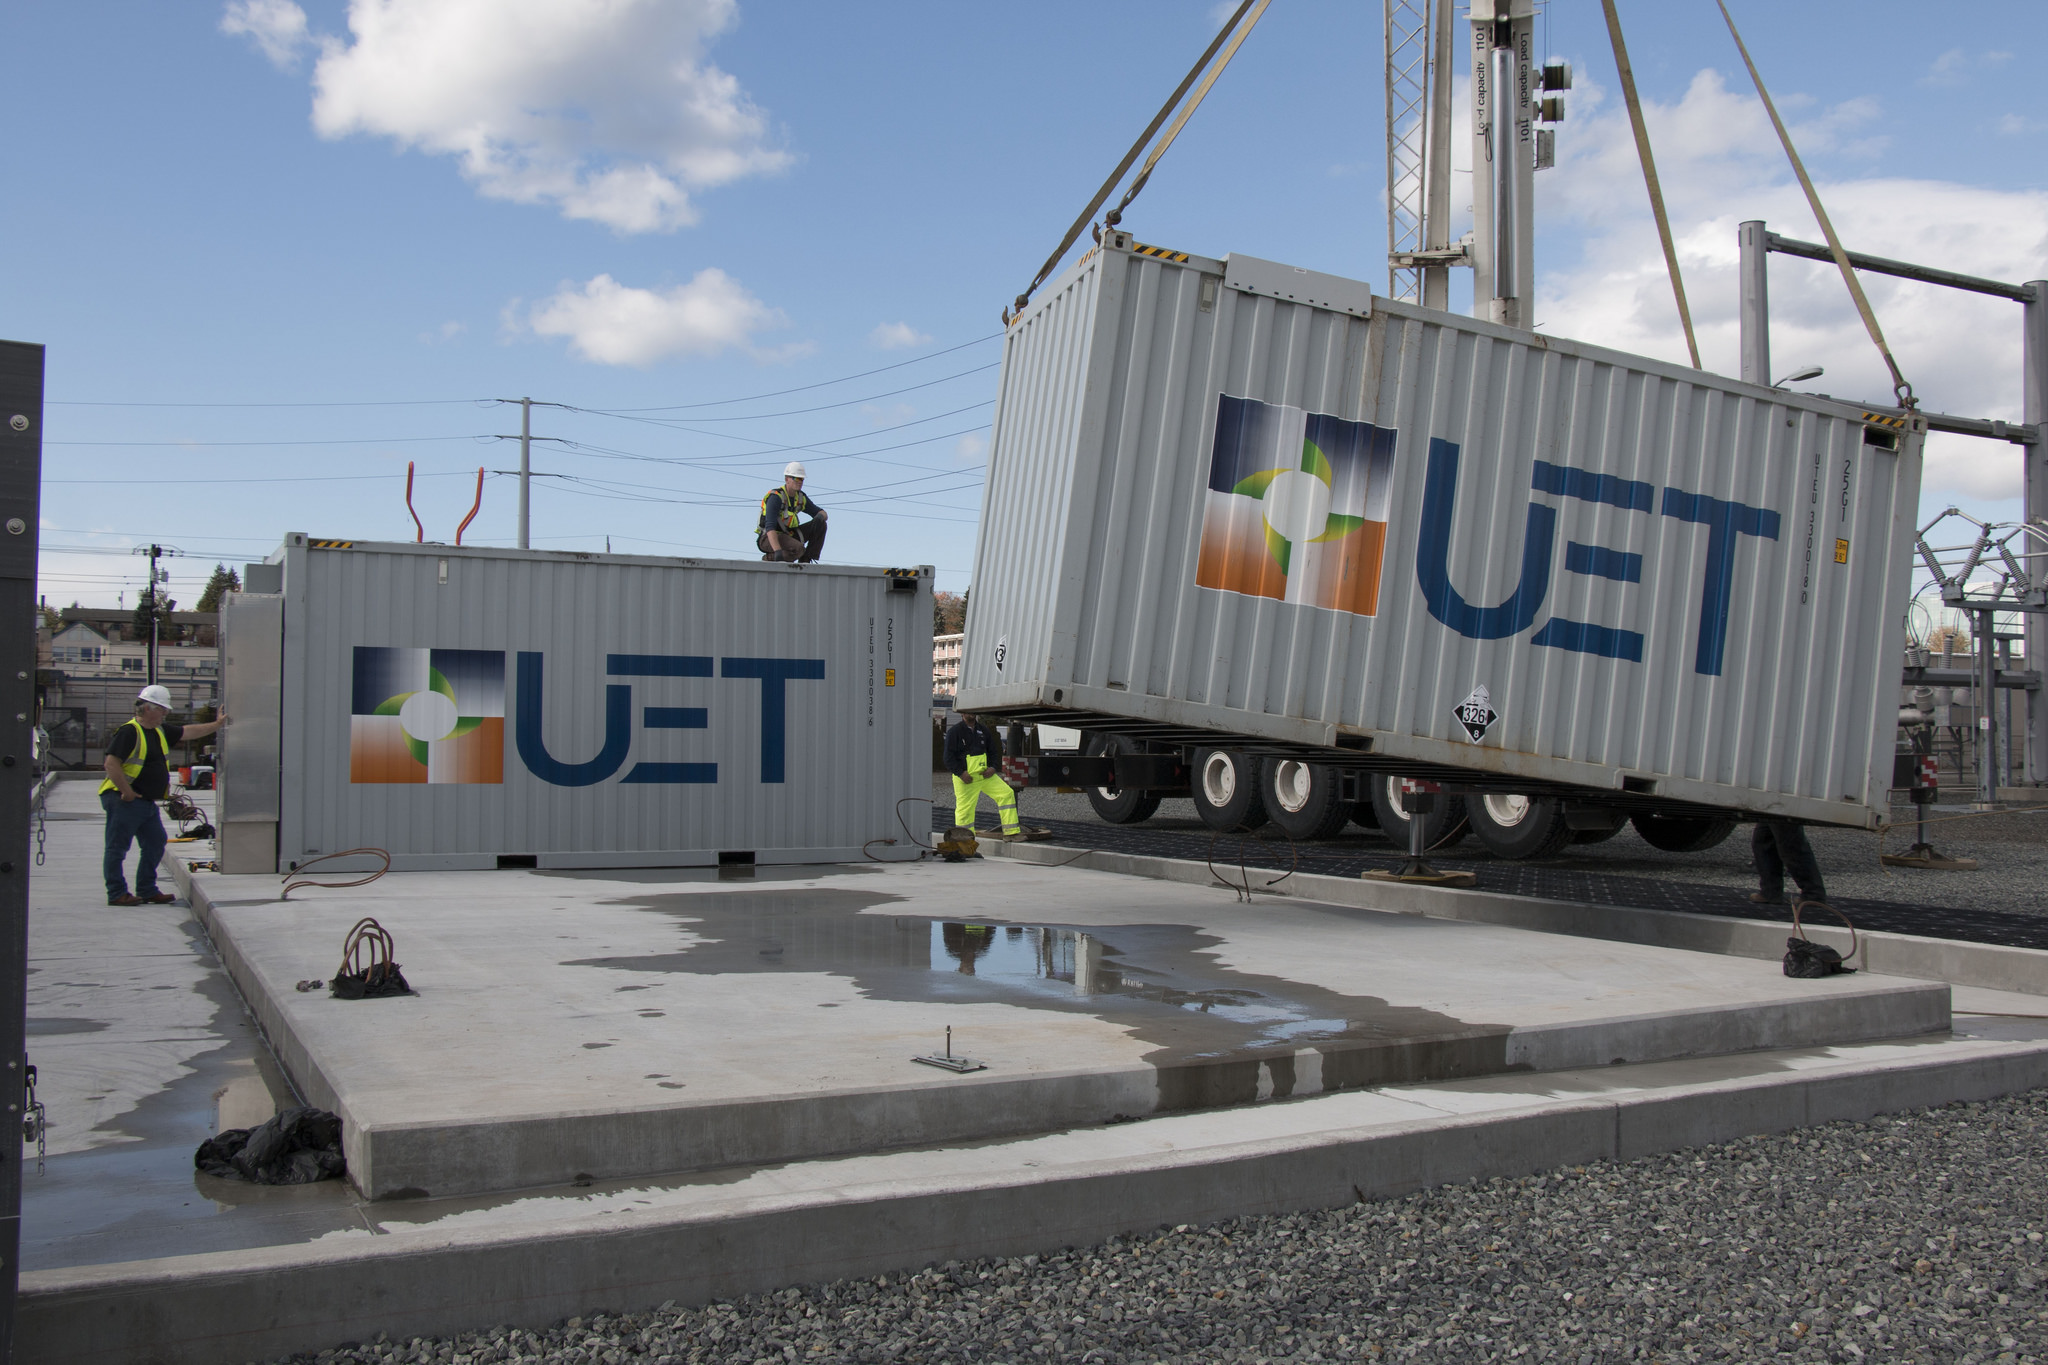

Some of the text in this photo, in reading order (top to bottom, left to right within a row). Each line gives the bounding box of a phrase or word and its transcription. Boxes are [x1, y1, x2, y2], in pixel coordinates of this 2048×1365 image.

[1520, 32, 1530, 61] Load
[1476, 61, 1487, 106] capacity
[1519, 64, 1529, 109] capacity
[1476, 108, 1486, 136] Lod
[1841, 459, 1851, 522] 25G1
[1416, 436, 1781, 677] UET
[515, 650, 826, 788] UET
[1474, 730, 1480, 738] 8
